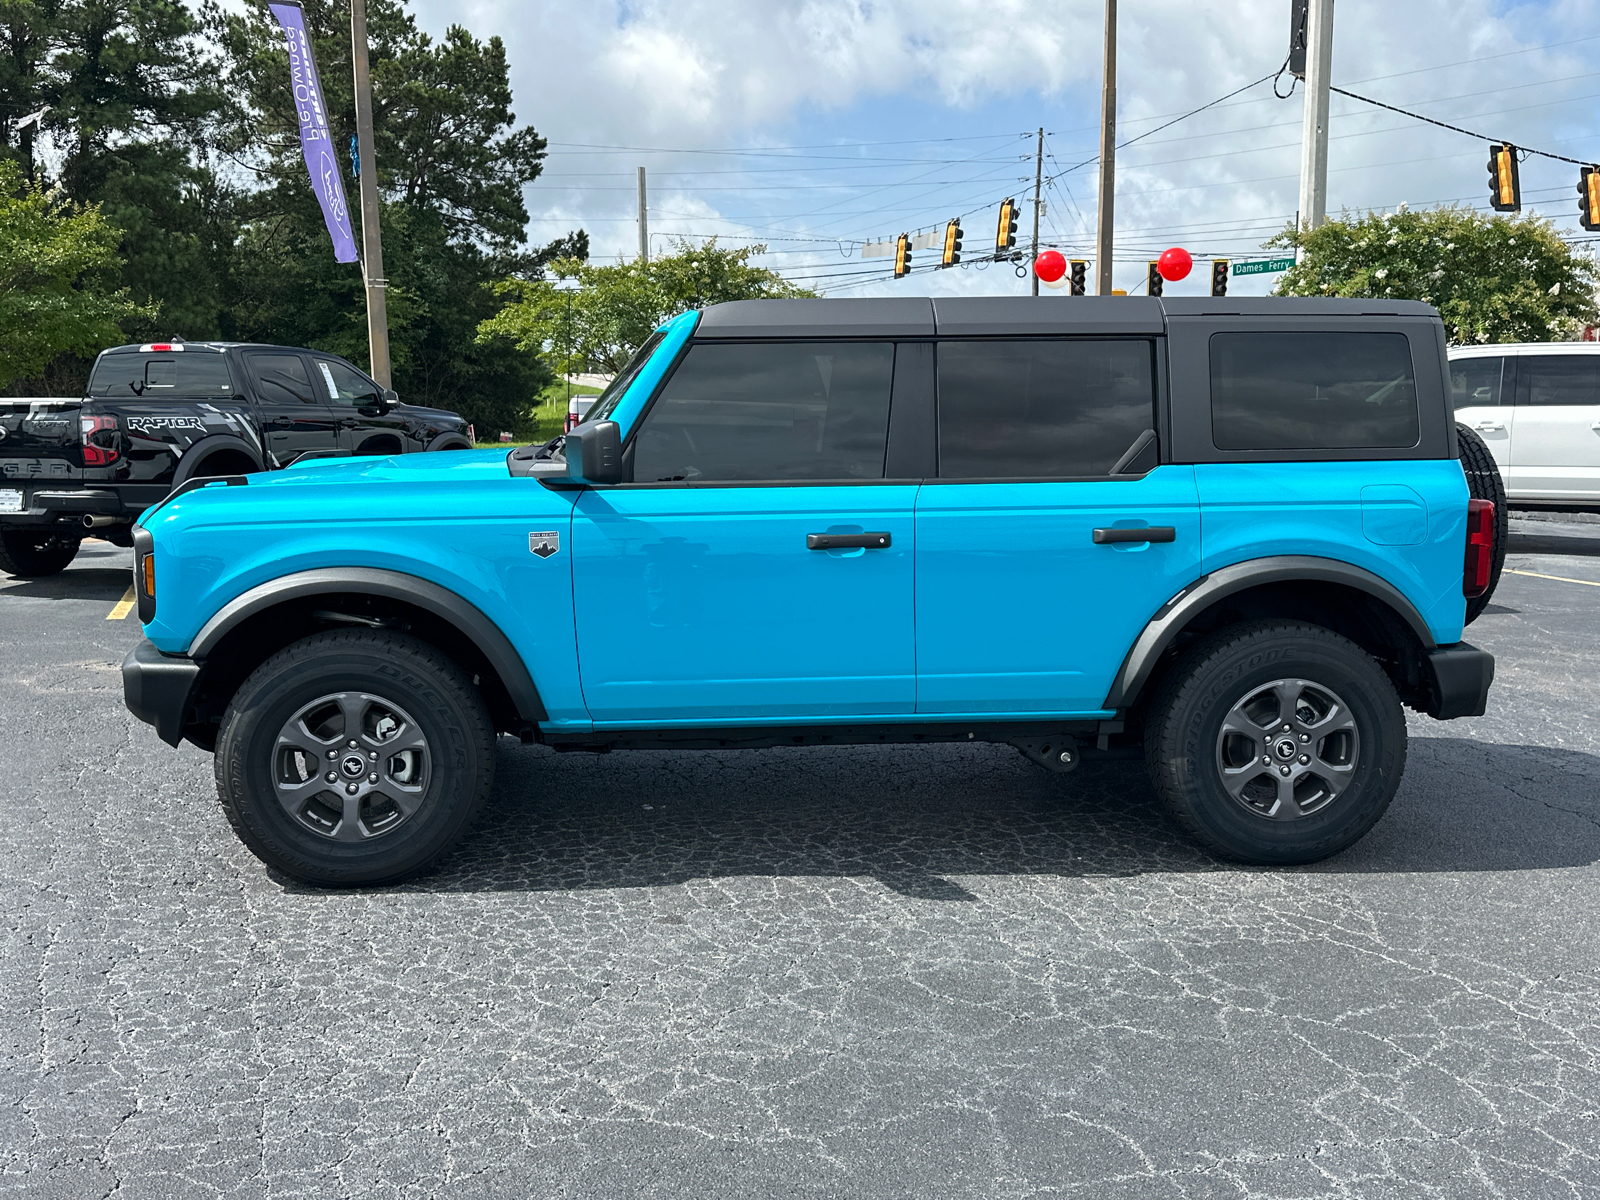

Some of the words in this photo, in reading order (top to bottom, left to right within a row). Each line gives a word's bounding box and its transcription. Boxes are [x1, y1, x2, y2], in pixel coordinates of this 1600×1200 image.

[1236, 264, 1263, 273] Dames
[1268, 261, 1290, 270] Ferry
[126, 416, 208, 435] RAPTOR
